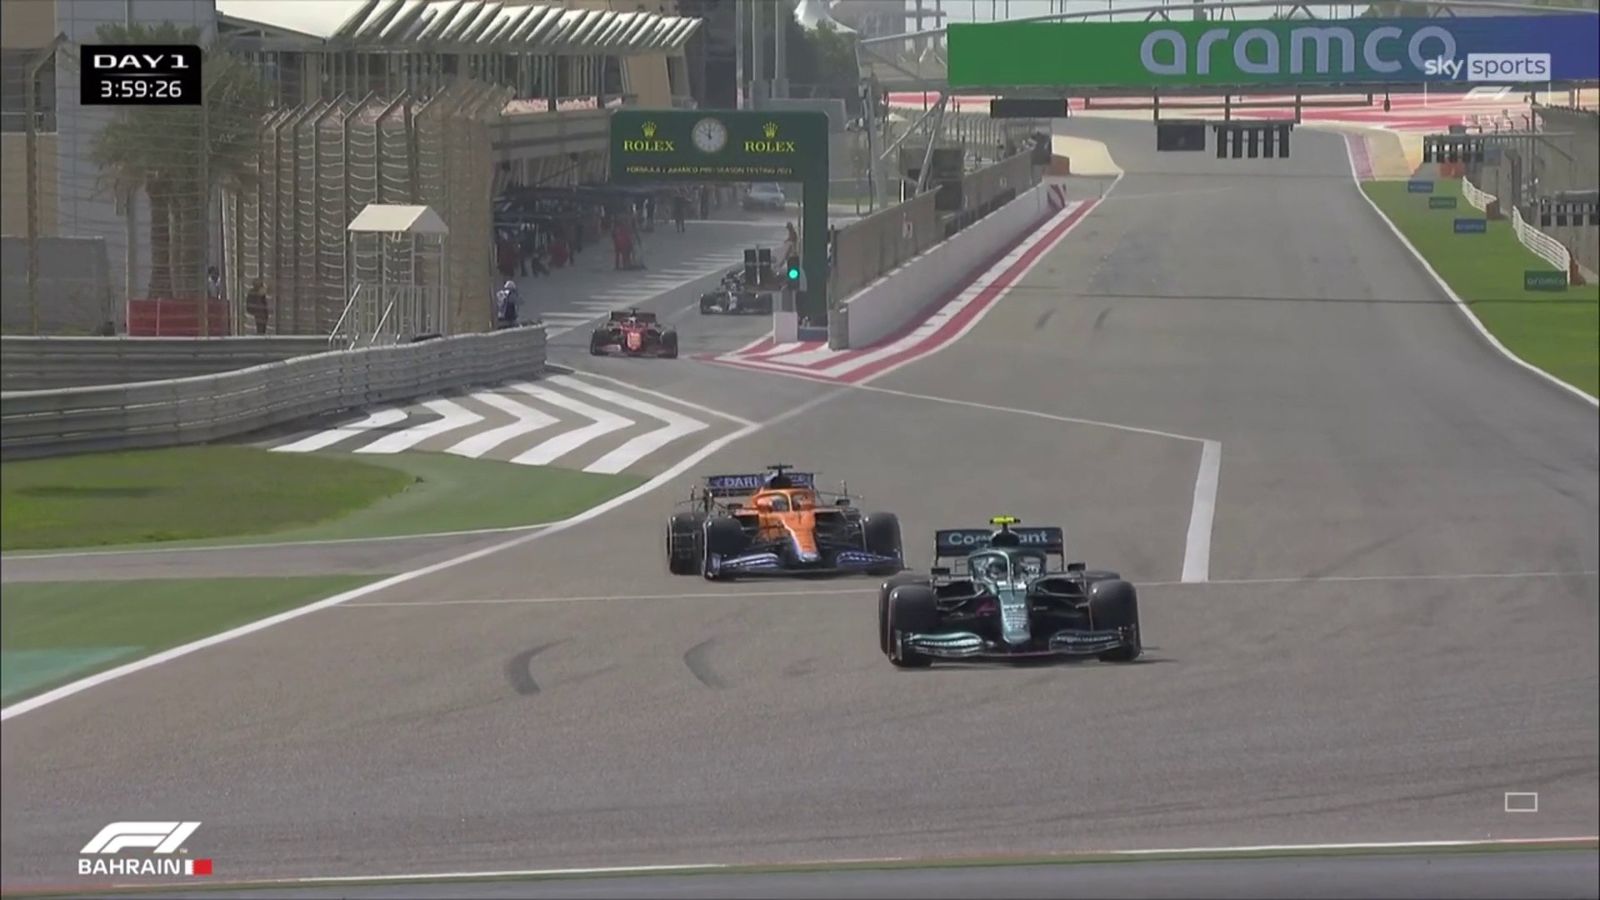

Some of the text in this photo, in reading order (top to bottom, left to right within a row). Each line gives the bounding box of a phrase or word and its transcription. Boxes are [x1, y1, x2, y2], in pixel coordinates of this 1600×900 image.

[1140, 25, 1457, 75] aramco
[623, 140, 675, 152] ROLEX
[744, 141, 795, 152] ROLEX
